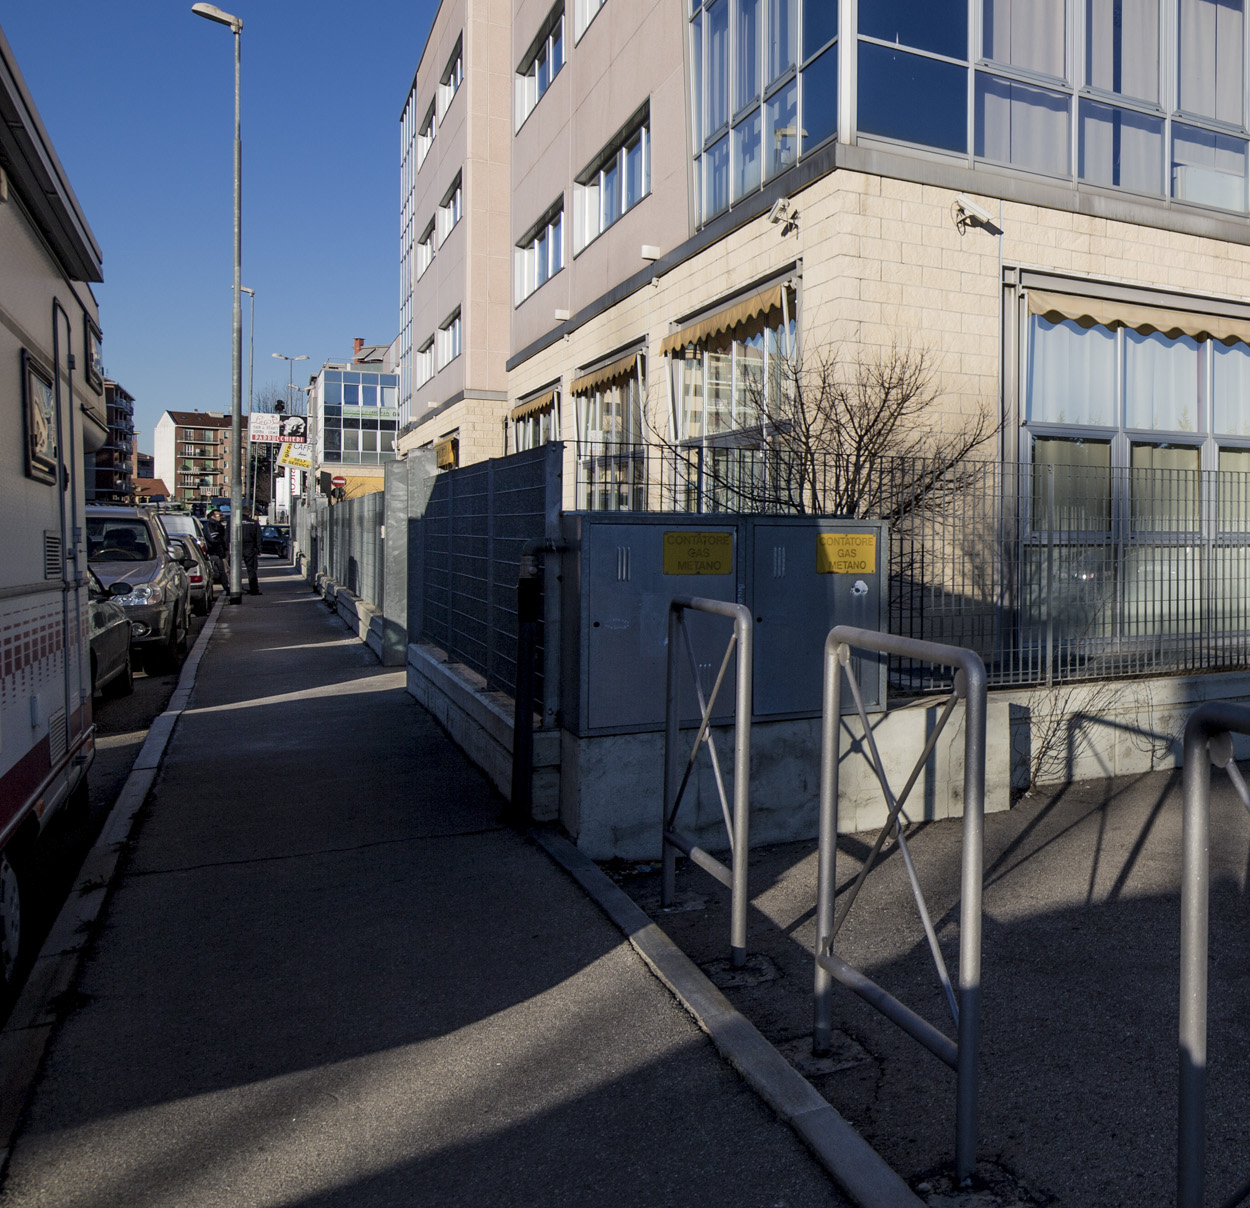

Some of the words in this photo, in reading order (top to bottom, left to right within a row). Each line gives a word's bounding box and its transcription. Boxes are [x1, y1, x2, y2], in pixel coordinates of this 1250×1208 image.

[667, 535, 729, 545] CONTATORE
[820, 536, 873, 546] CONTATORE
[687, 548, 710, 558] GAS
[837, 548, 857, 558] GAS
[677, 560, 721, 570] METANO
[828, 560, 866, 570] METANO
